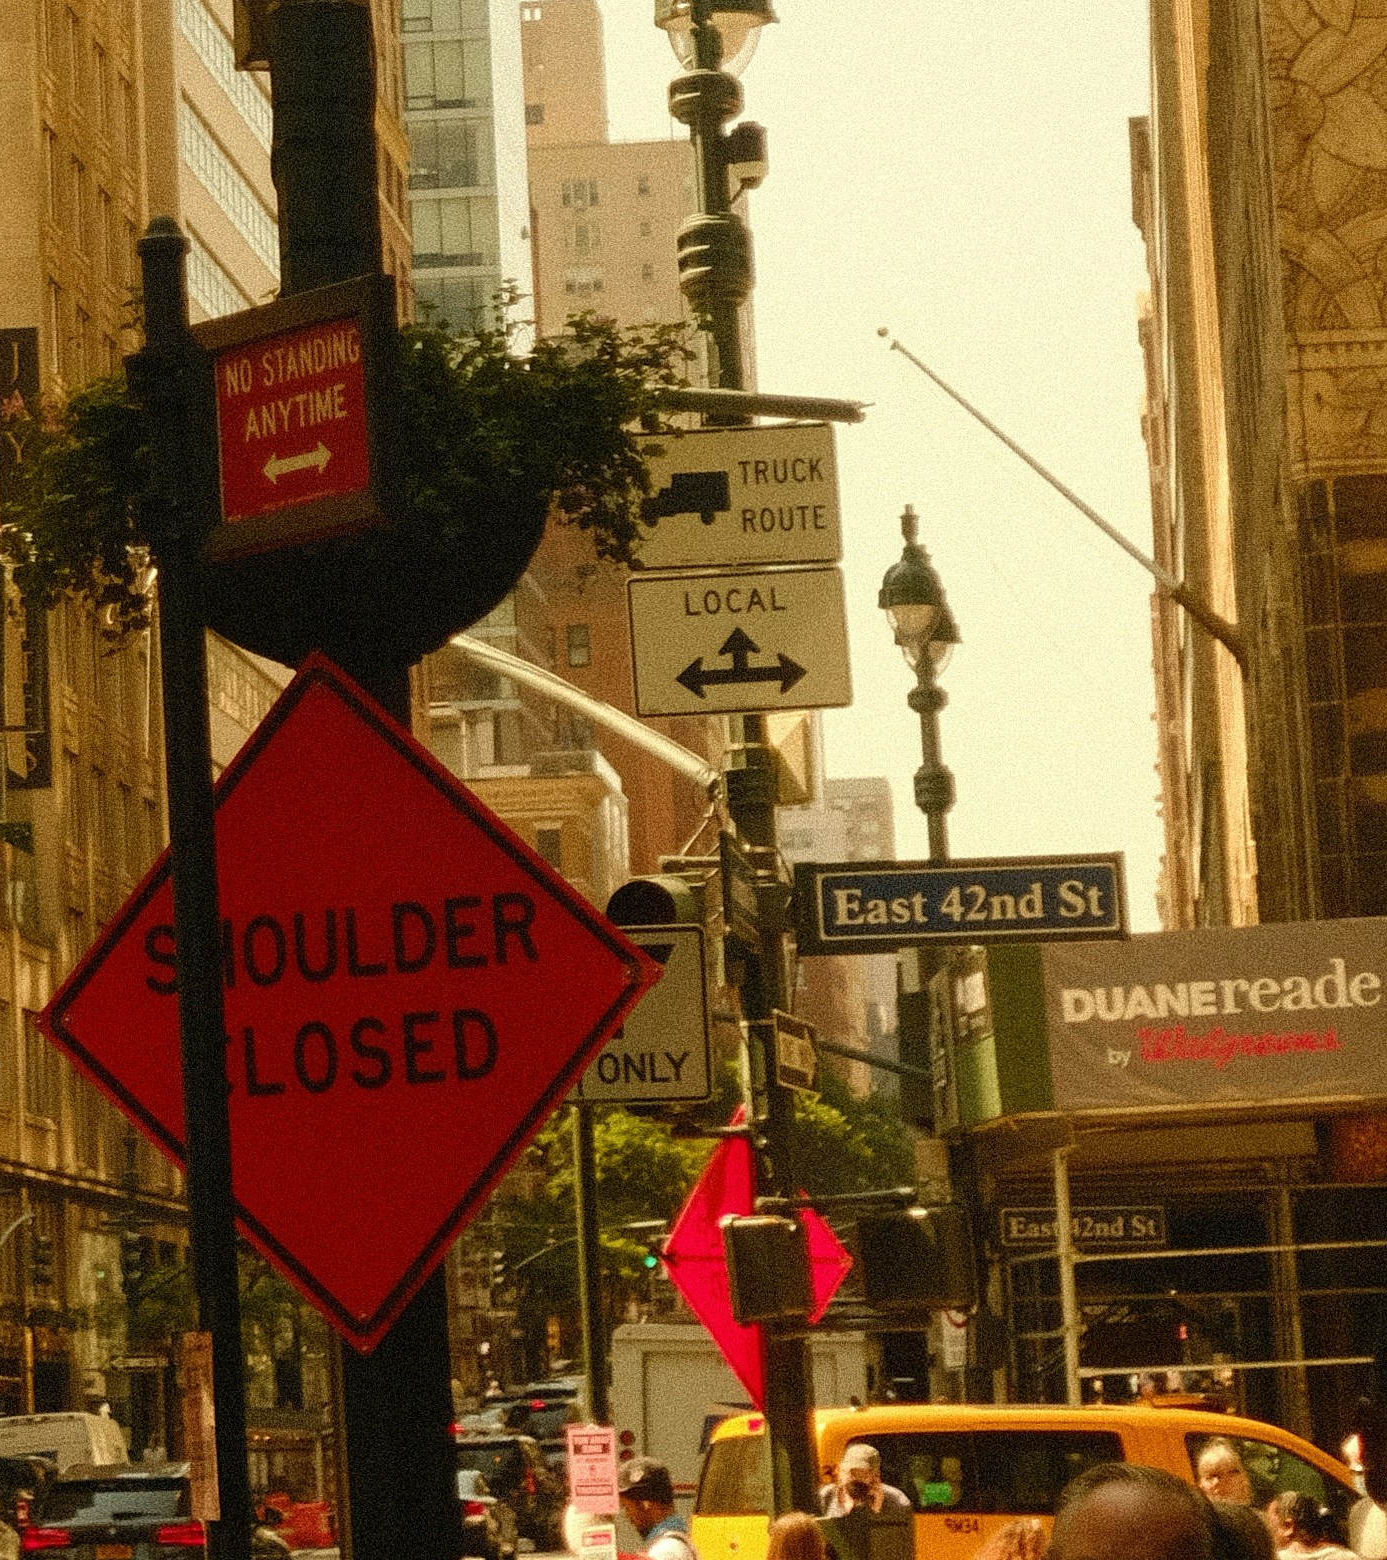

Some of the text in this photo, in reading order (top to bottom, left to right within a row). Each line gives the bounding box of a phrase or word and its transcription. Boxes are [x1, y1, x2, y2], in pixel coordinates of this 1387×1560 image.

[225, 329, 360, 398] NO STANDING
[245, 383, 348, 443] ANYTIME
[738, 458, 824, 485] TRUCK
[742, 505, 826, 533] ROUTE
[684, 587, 787, 616] LOCAL
[834, 880, 1104, 926] East 42nd St
[223, 1008, 499, 1097] LOSED
[1107, 1047, 1131, 1068] by
[597, 1052, 690, 1084] ONLY
[1132, 1215, 1156, 1237] St
